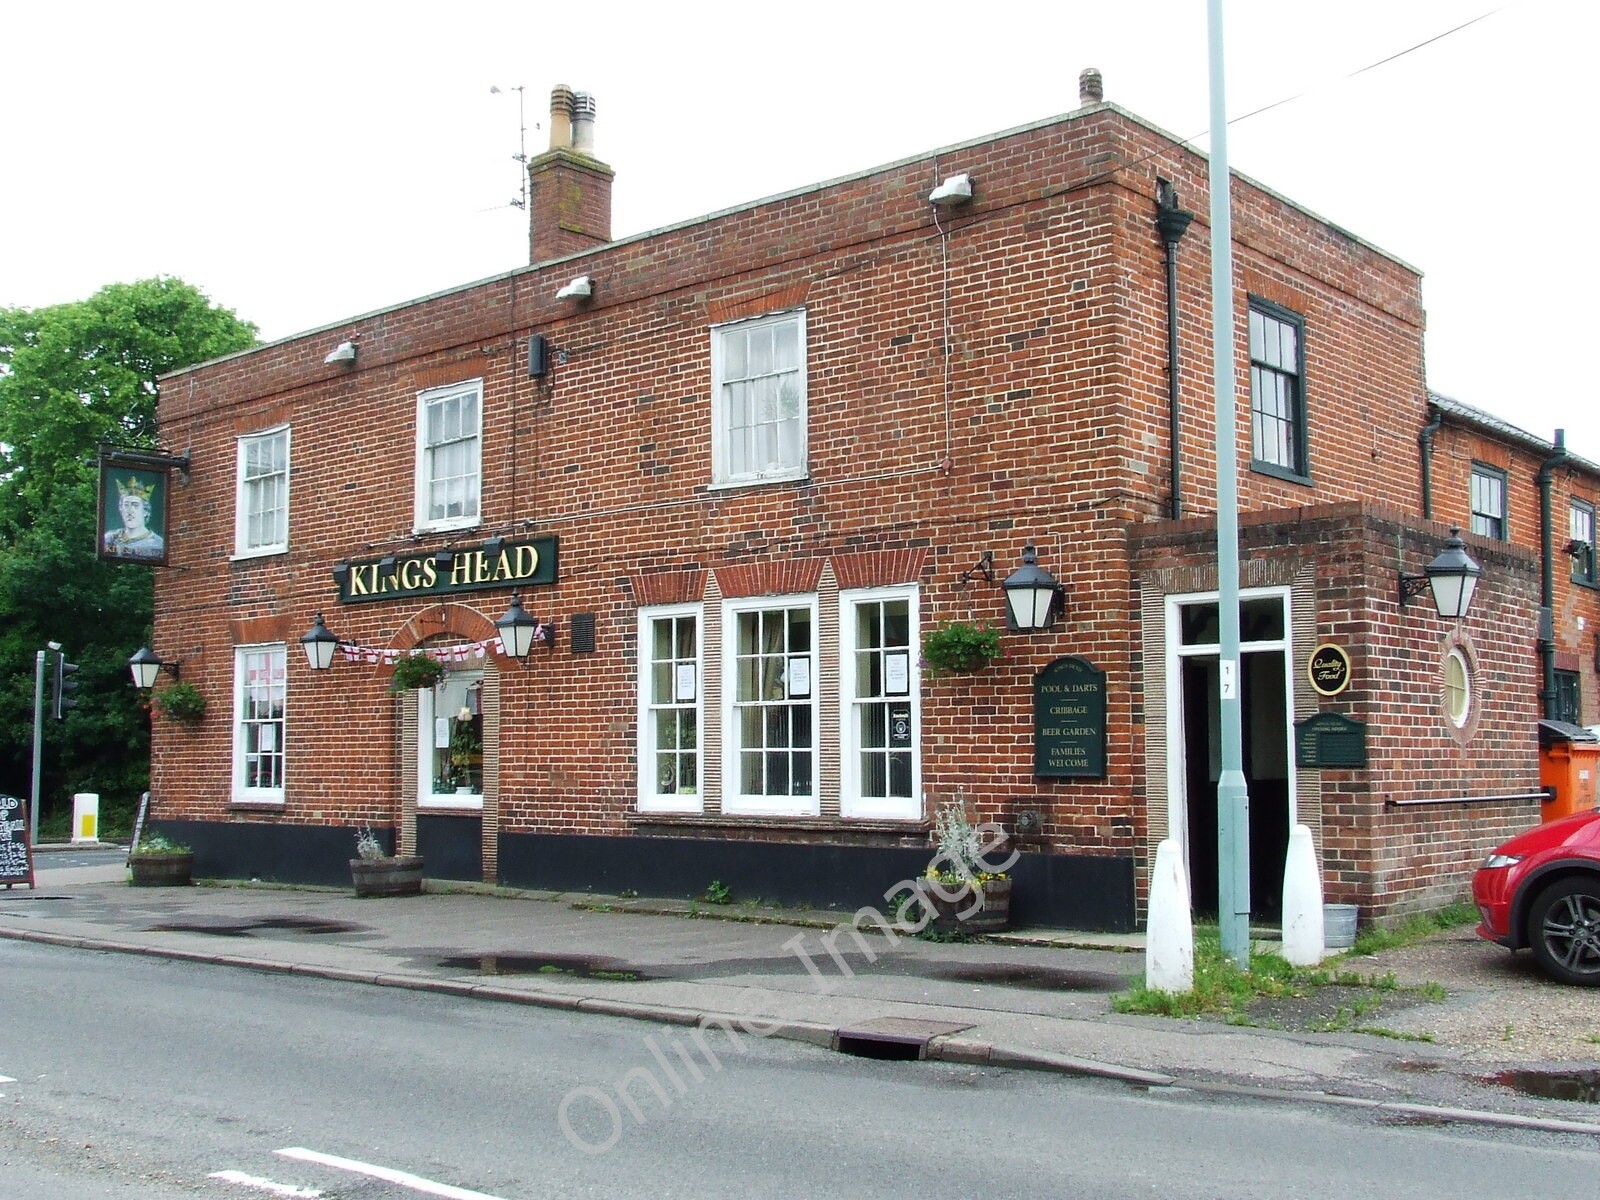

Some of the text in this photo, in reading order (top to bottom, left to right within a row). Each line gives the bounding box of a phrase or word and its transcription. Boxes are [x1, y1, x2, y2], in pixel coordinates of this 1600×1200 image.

[351, 545, 539, 595] KINGS HEAD
[1313, 659, 1345, 671] Quality
[1317, 670, 1340, 680] Food
[1041, 684, 1098, 693] POOL & DARTS
[1049, 706, 1088, 714] CRIBBAGE
[1042, 727, 1096, 736] BEER GARDEN
[1051, 747, 1086, 756] FAMILIES
[1048, 758, 1088, 767] WELCOME
